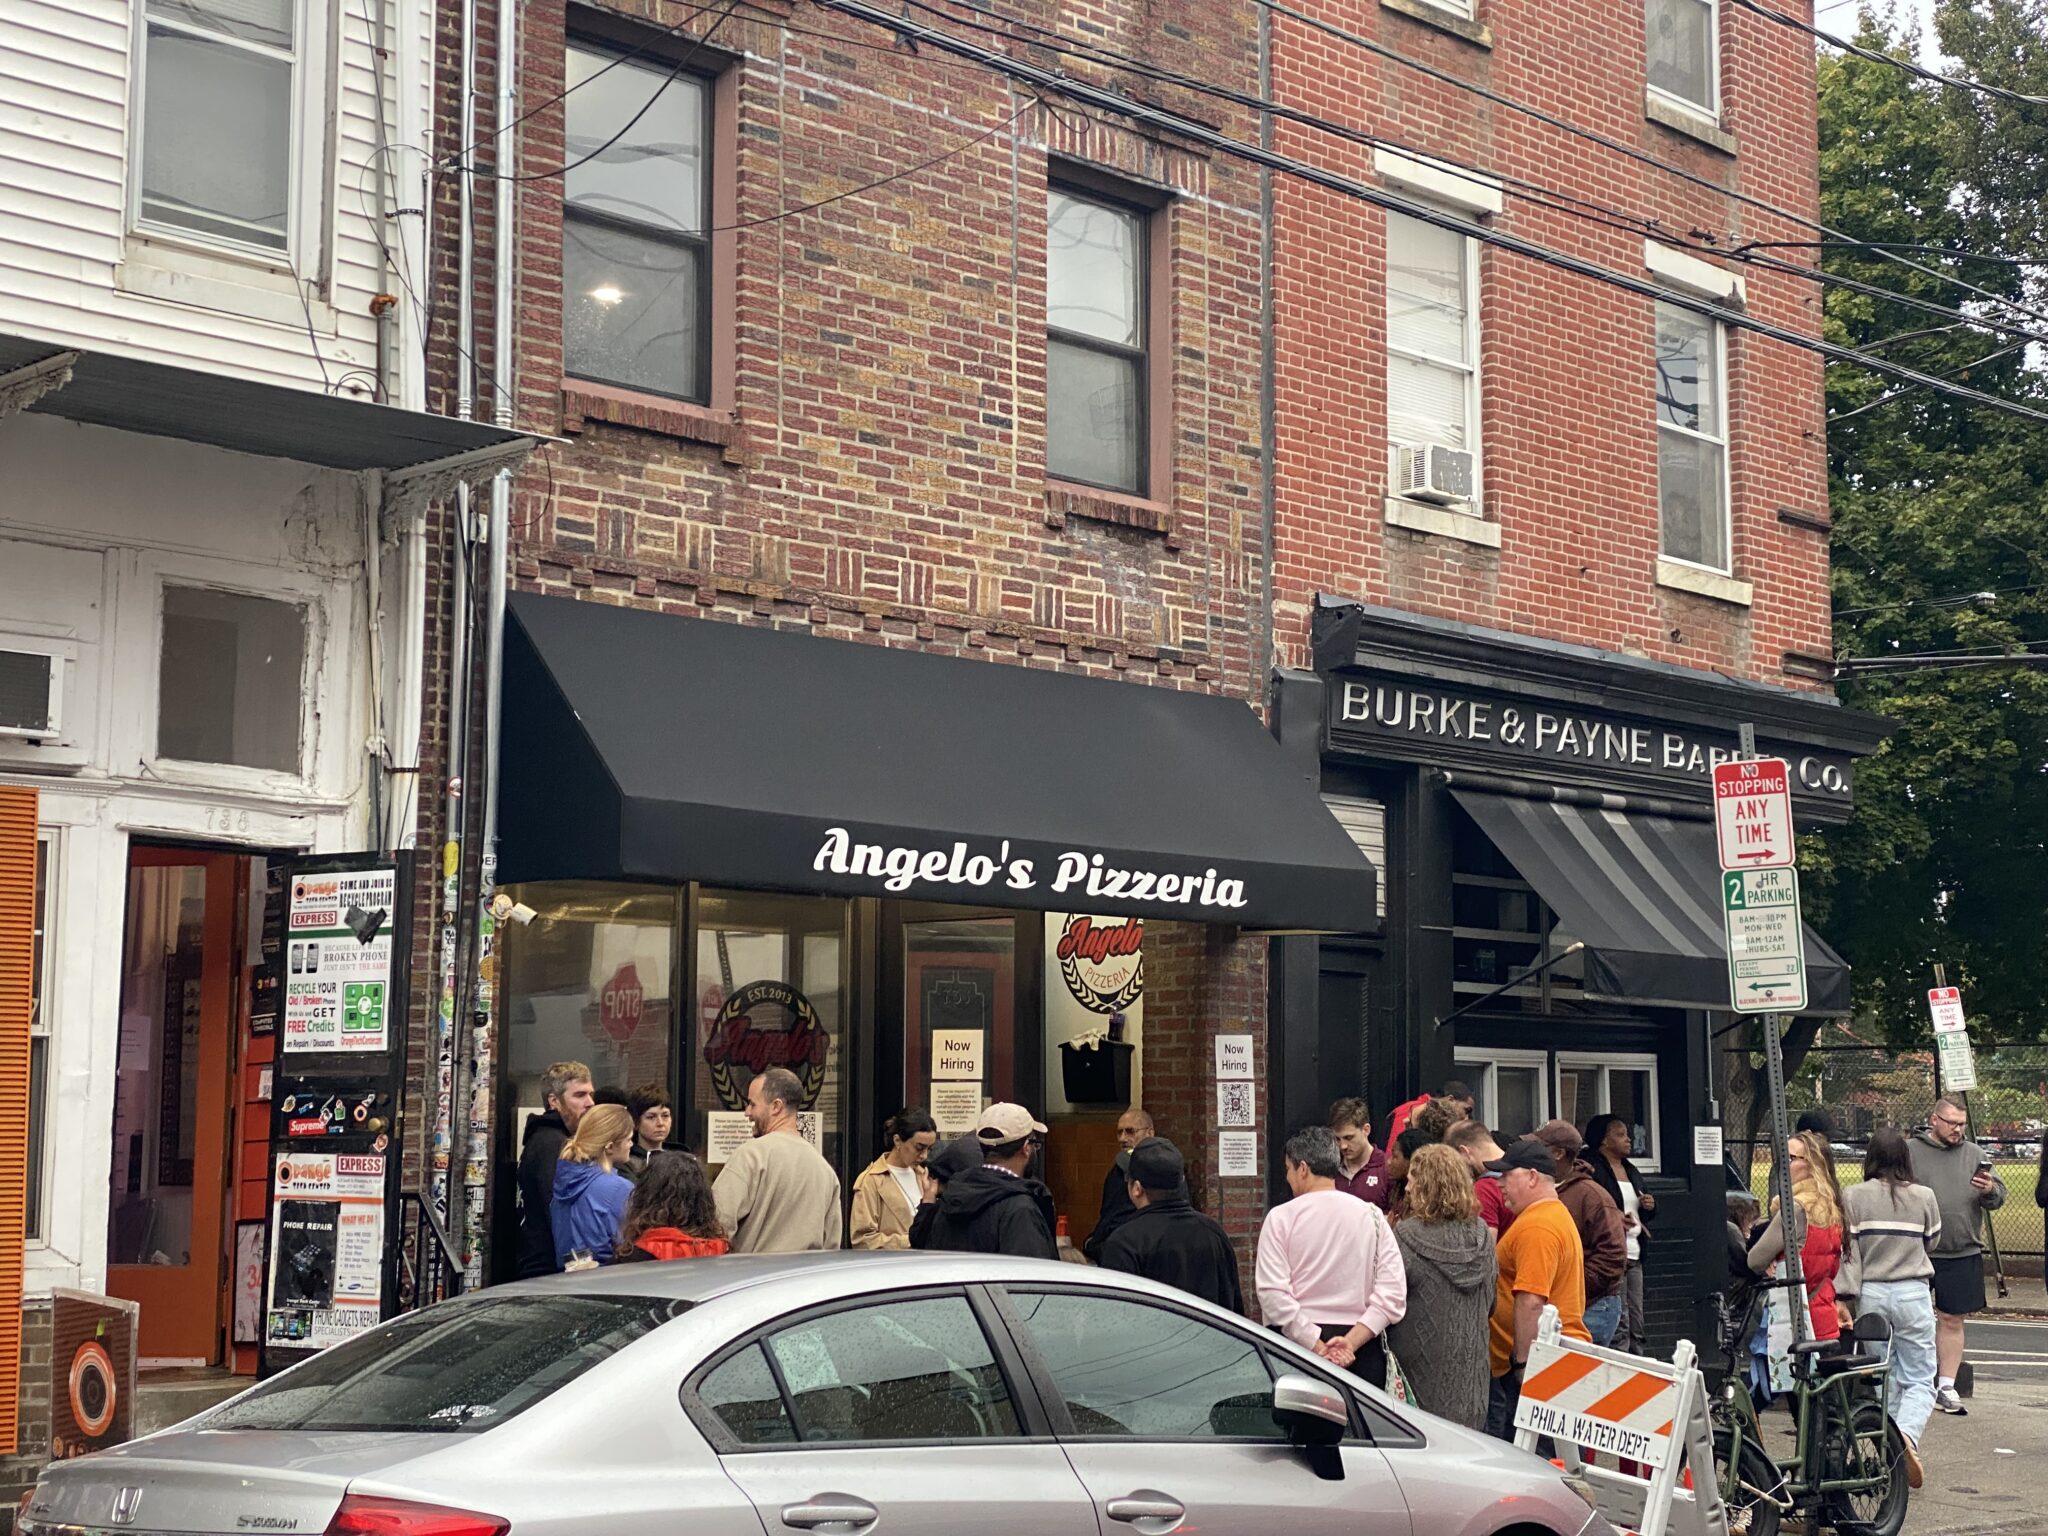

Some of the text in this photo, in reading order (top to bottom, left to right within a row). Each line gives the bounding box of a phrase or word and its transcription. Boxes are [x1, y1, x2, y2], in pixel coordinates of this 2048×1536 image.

[1342, 681, 1492, 740] BURKE
[1500, 708, 1525, 744] &
[1535, 713, 1652, 763] PAYNE
[1740, 764, 1759, 779] NO
[1719, 777, 1784, 796] STOPPING
[1736, 799, 1768, 820] ANY
[1736, 823, 1772, 844] TIME
[813, 827, 1248, 908] Angelo's Pizzeria
[340, 880, 357, 890] COME
[359, 880, 369, 890] AND
[1729, 872, 1778, 905] 2 HR
[340, 891, 392, 908] RECYCLE PROGRAM
[1748, 888, 1792, 904] PARKING
[295, 913, 334, 924] EXPRESS
[1744, 923, 1782, 932] MON-WED
[324, 952, 388, 962] BROKEN PHONE
[1786, 964, 1795, 972] 22
[1084, 967, 1130, 989] PIZZERIA
[289, 982, 336, 994] RECYCLE YOUR
[288, 996, 298, 1006] Old
[304, 996, 322, 1006] Broken
[769, 988, 792, 1004] 2013
[313, 1008, 336, 1018] GET
[288, 1020, 306, 1032] FREE
[307, 1020, 334, 1032] Credits
[313, 1039, 334, 1047] Discounts
[945, 1040, 970, 1051] Now
[1224, 1044, 1244, 1054] Now
[1940, 1038, 1948, 1049] 2
[940, 1058, 974, 1072] Hiring
[1222, 1060, 1248, 1072] Hiring
[291, 1120, 325, 1134] Supreme
[340, 1158, 381, 1172] EXPRESS
[283, 1221, 332, 1231] PHONE REPAIR
[315, 1309, 378, 1327] PHONE GADGETS REPAIR
[314, 1327, 350, 1336] SPECIALISTS
[1529, 1405, 1651, 1461] PHILA. WATER DEPT.
